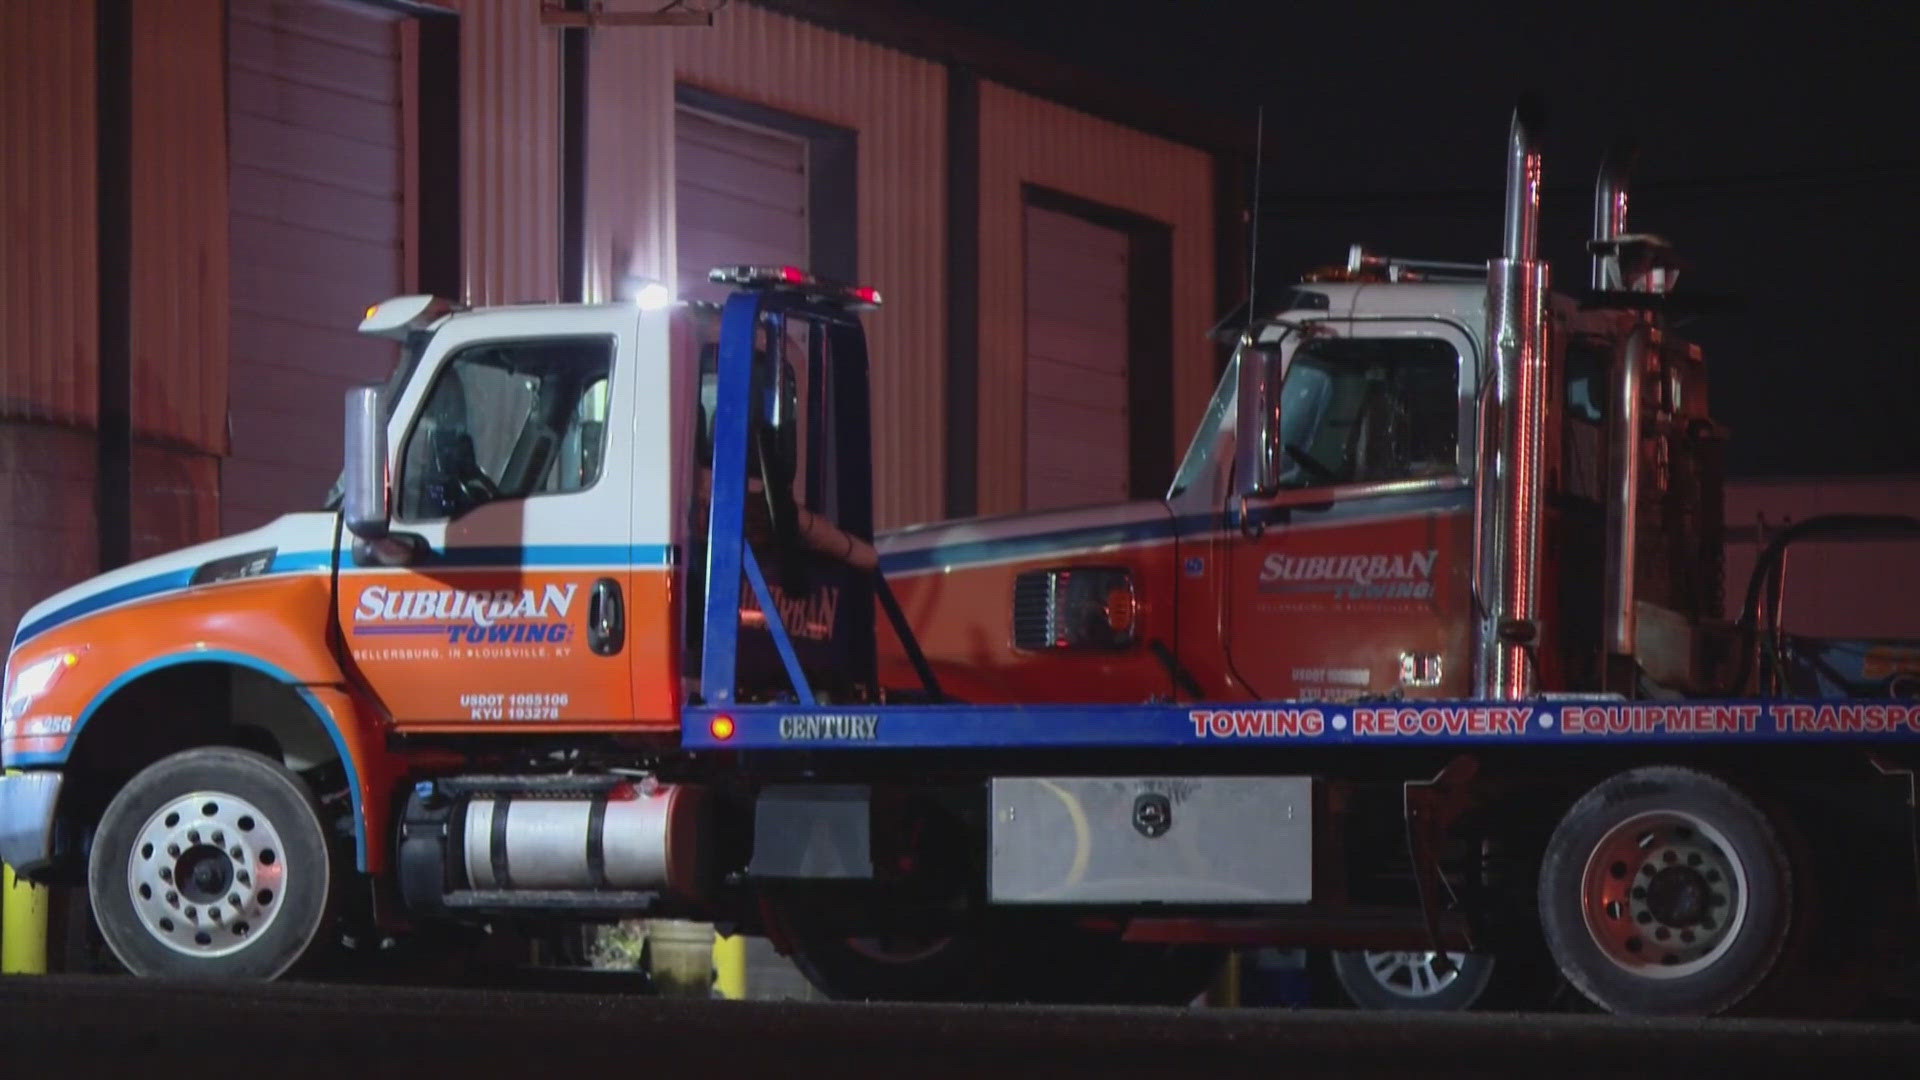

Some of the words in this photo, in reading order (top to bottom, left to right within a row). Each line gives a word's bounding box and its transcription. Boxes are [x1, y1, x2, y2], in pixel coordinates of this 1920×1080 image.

[1259, 549, 1439, 585] SUBURBAN
[1334, 581, 1432, 600] TOWING
[355, 583, 578, 627] SUBURBAN
[447, 622, 568, 644] TOWING
[555, 647, 571, 657] KY
[461, 694, 504, 707] USDOT
[471, 708, 502, 721] KYU
[1190, 709, 1325, 738] TOWING
[1353, 707, 1533, 736] RECOVERY
[1561, 705, 1761, 735] EQUIPMENT
[778, 714, 879, 740] CENTURY
